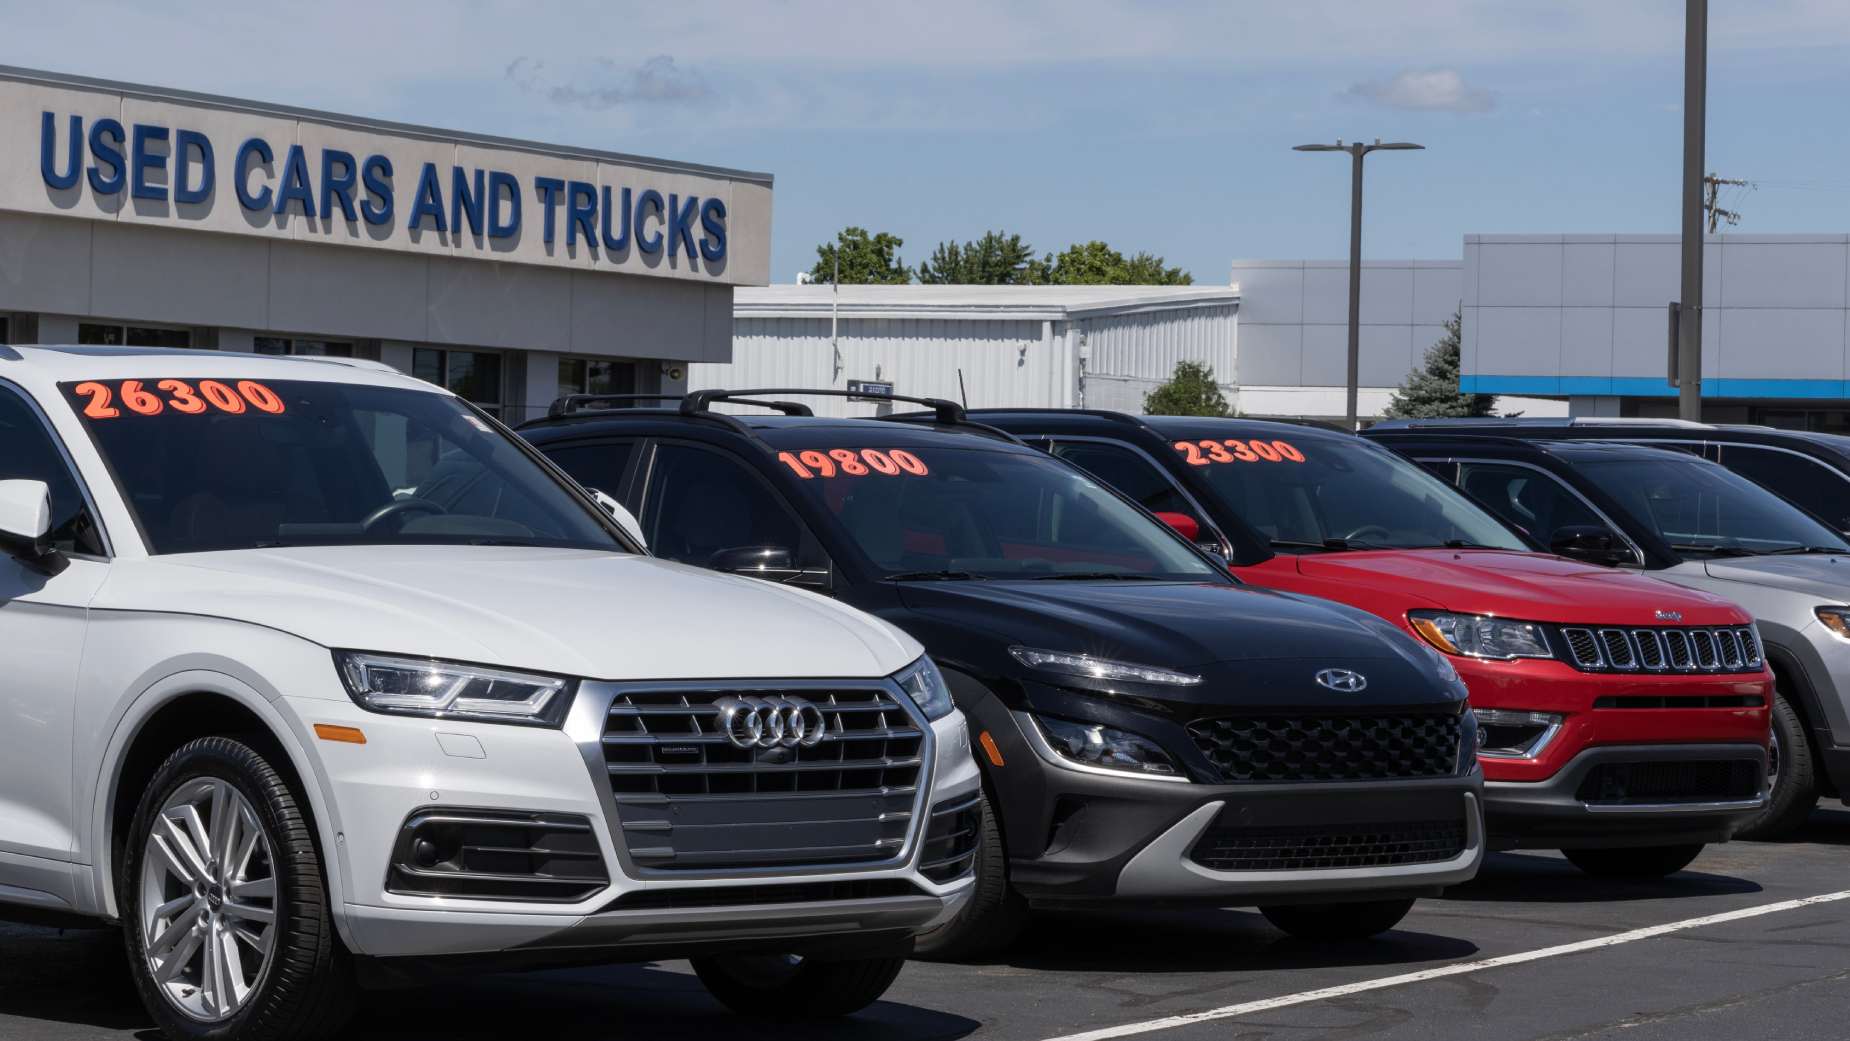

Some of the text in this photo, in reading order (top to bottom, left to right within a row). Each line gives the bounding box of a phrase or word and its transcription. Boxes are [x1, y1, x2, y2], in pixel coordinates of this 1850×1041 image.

[41, 111, 727, 262] USED CARS AND TRUCKS
[75, 379, 286, 419] 26300
[778, 449, 929, 479] 19800
[1174, 440, 1306, 466] 23300
